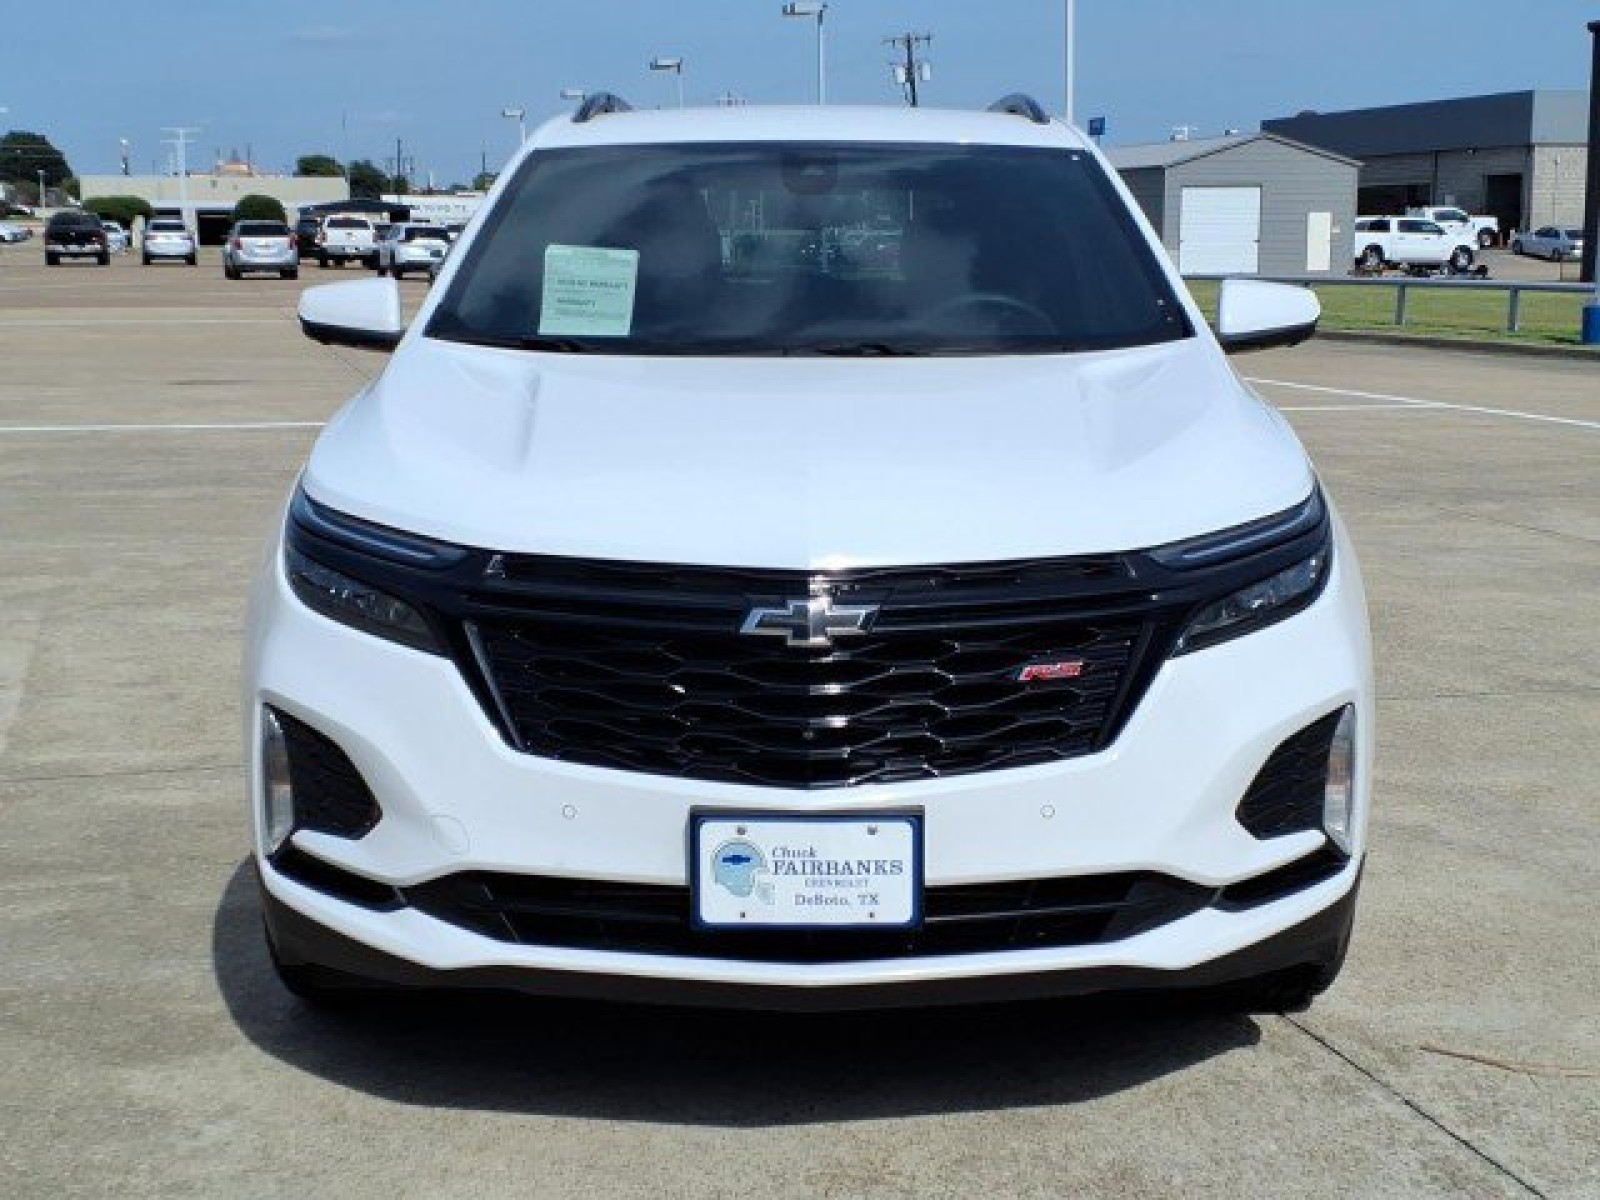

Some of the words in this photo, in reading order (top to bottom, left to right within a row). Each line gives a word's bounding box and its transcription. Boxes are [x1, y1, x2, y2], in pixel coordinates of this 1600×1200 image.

[1019, 661, 1083, 681] RS
[772, 845, 818, 858] Chuck
[772, 859, 904, 876] FAIRBANKS
[857, 893, 880, 906] TX
